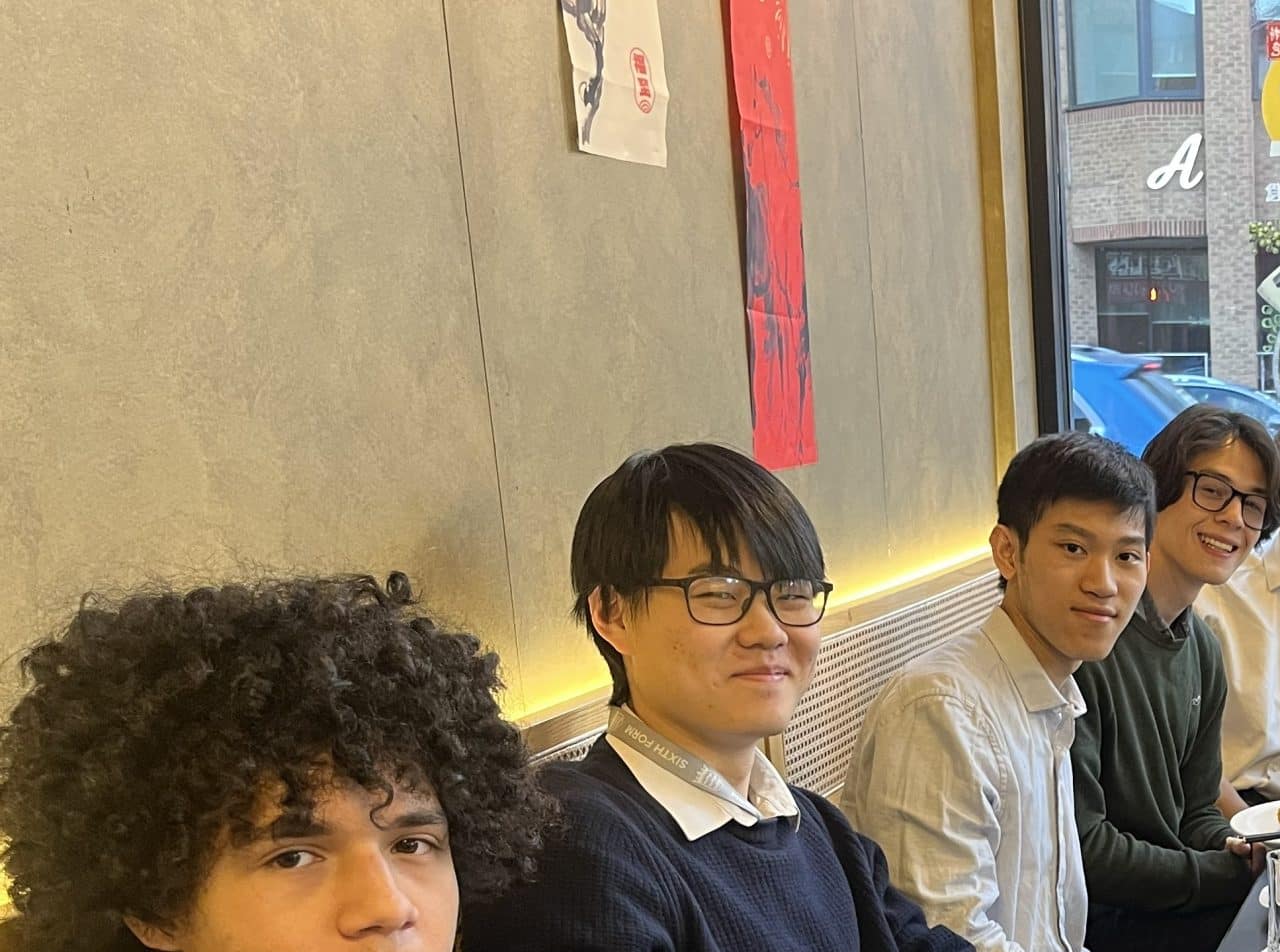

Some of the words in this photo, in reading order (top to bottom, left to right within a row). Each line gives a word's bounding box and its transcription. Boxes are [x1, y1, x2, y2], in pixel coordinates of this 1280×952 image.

[1146, 133, 1205, 190] A
[624, 724, 654, 749] FORM
[653, 740, 690, 769] SIXTH
